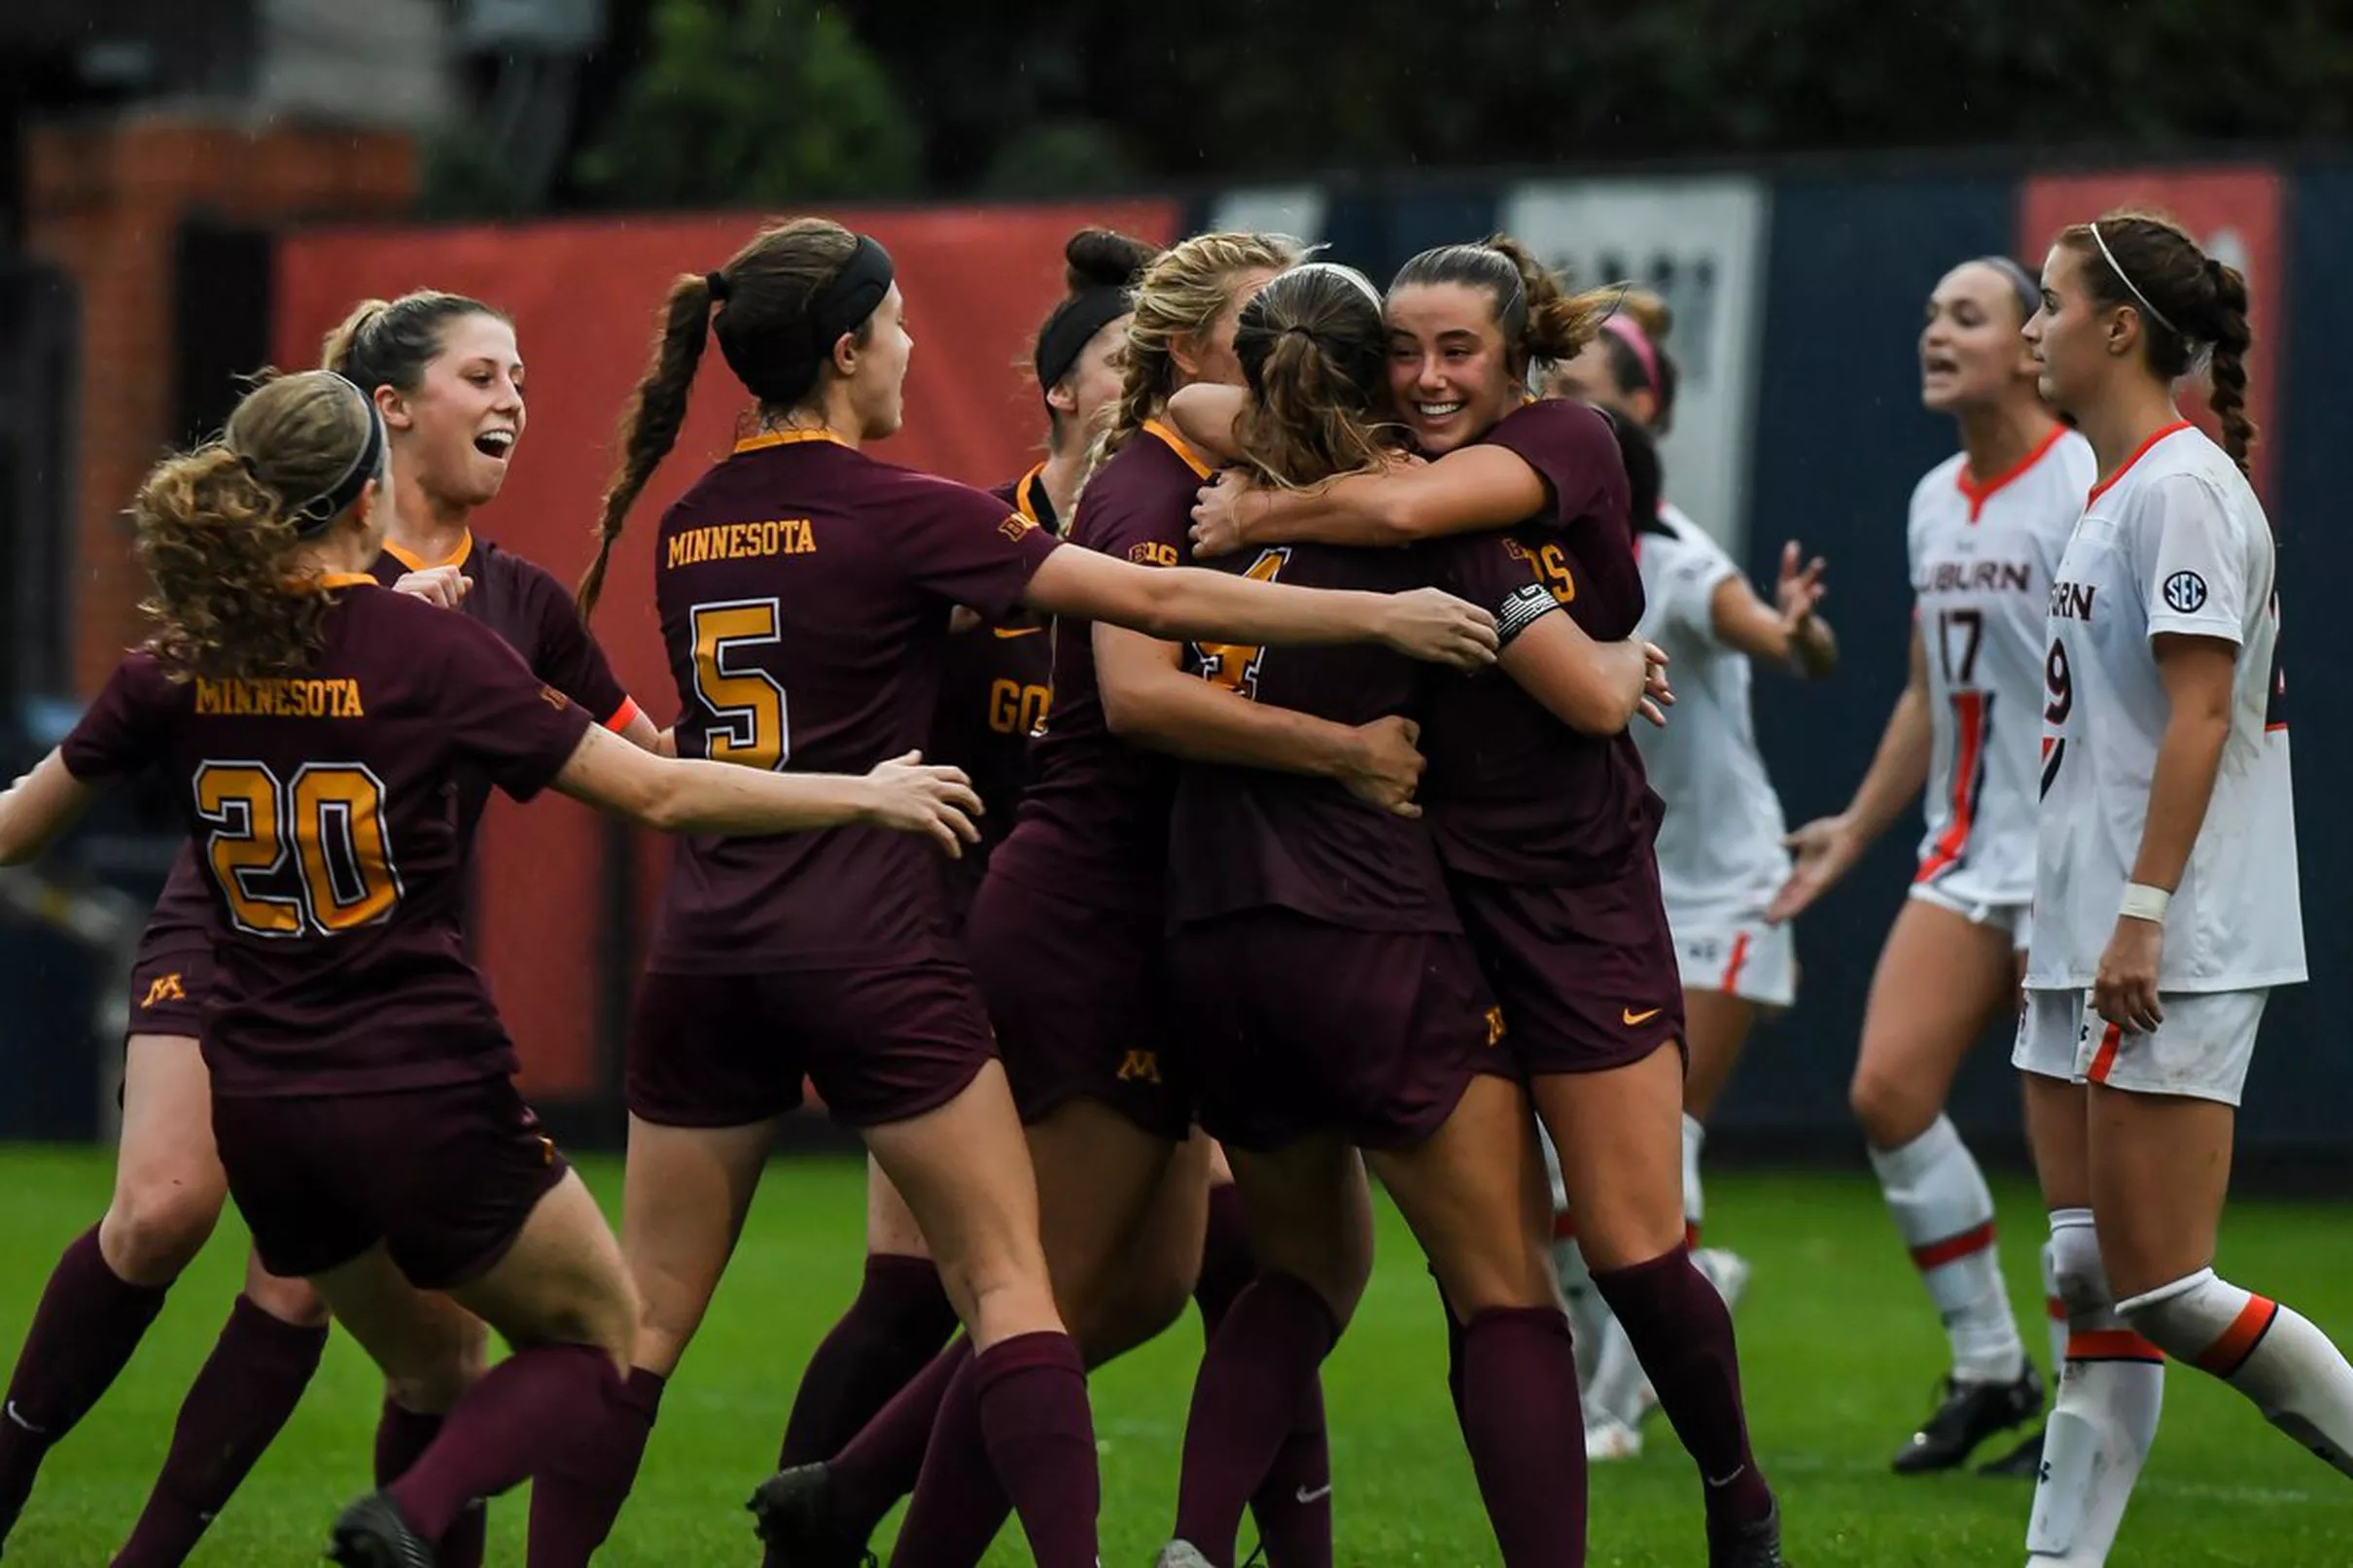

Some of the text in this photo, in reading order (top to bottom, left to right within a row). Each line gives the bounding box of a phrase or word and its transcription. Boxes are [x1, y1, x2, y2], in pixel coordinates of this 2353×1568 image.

[667, 519, 817, 570] MINNESOTA
[2164, 572, 2207, 612] SEC
[1940, 609, 1983, 682] 17
[195, 679, 364, 717] MINNESOTA
[690, 597, 790, 772] 5
[193, 758, 404, 937] 20
